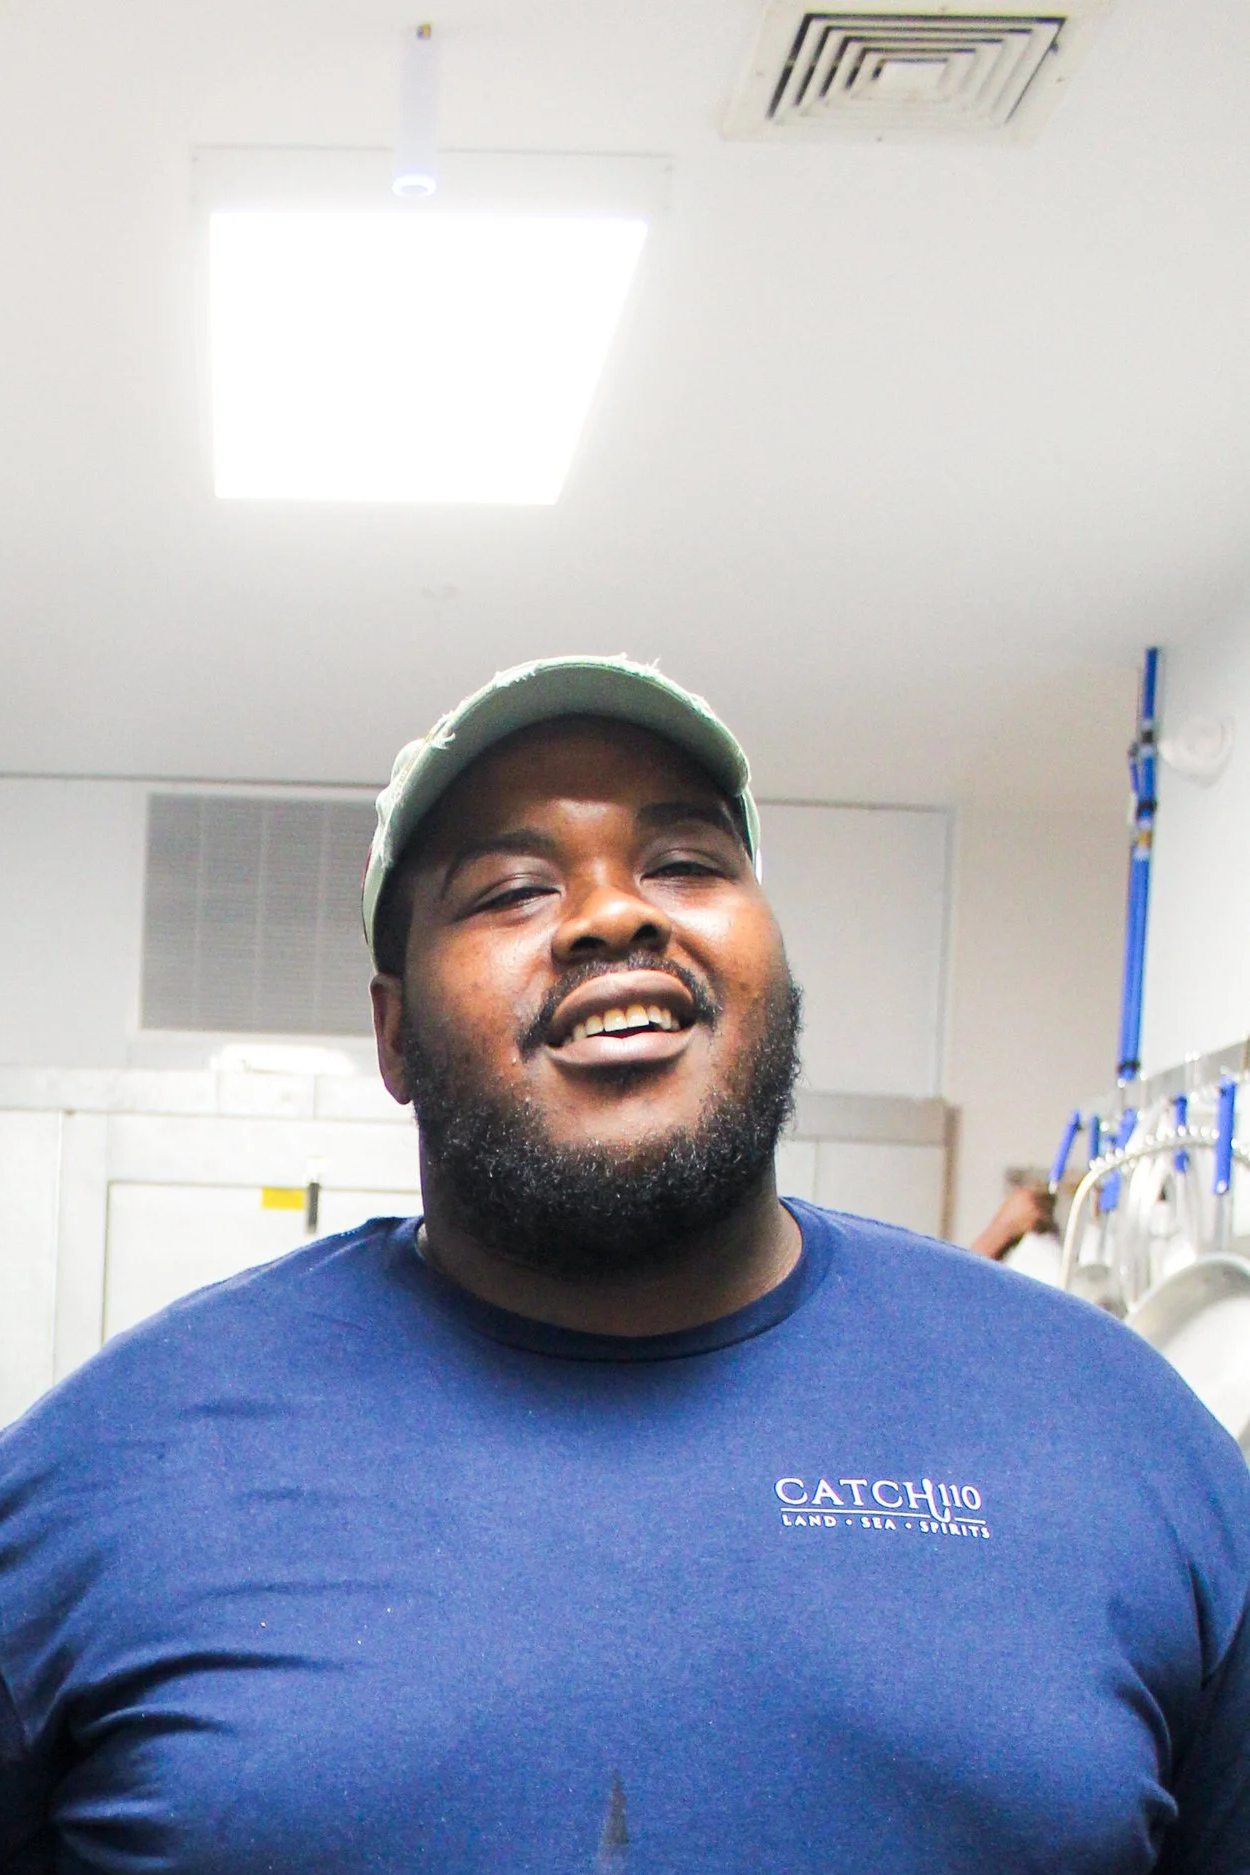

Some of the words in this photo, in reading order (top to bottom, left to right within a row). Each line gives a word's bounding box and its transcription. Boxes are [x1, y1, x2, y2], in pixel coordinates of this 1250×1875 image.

[781, 1513, 837, 1528] LAND
[861, 1516, 896, 1530] SEA
[919, 1521, 991, 1539] SPIRITS
